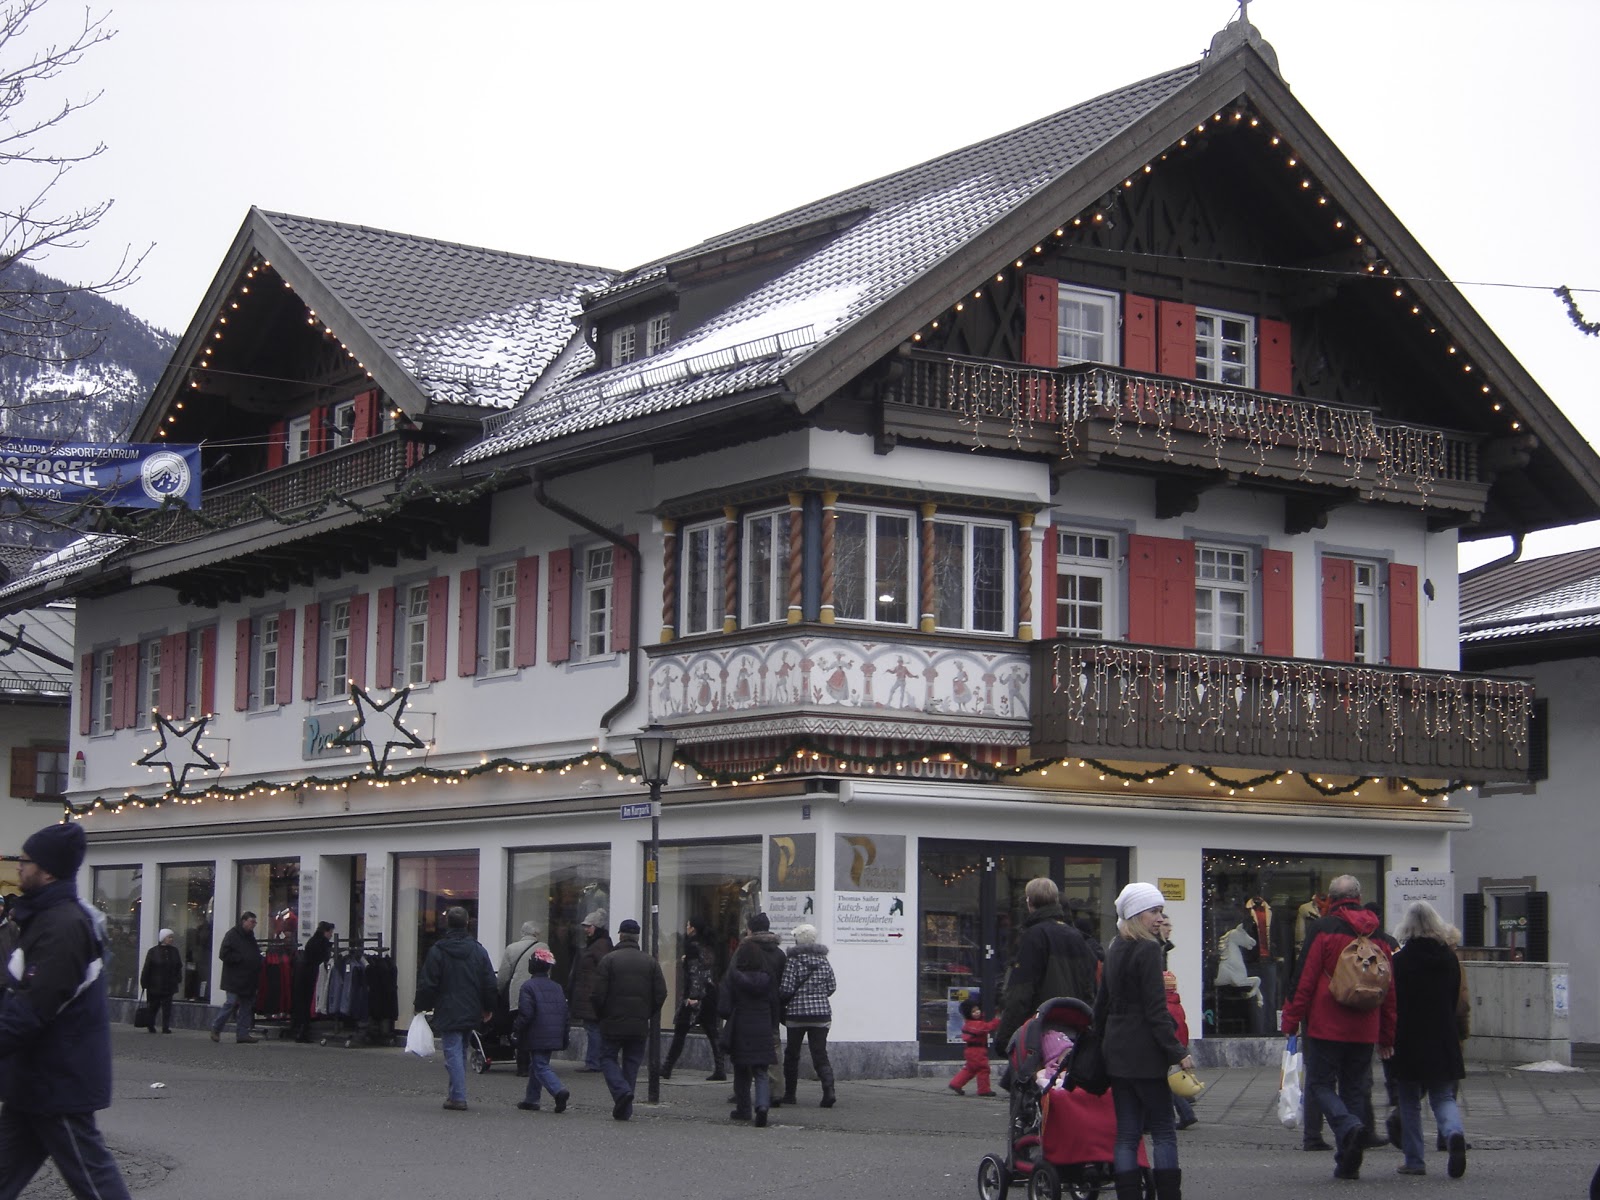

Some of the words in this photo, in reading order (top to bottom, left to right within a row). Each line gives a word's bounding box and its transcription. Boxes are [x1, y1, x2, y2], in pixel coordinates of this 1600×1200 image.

[0, 456, 99, 486] SERSEE
[624, 806, 631, 816] Am
[632, 805, 650, 817] Kurpark
[836, 902, 863, 912] Kutsch-
[864, 902, 880, 912] und
[836, 914, 894, 926] Schlittenfahrten
